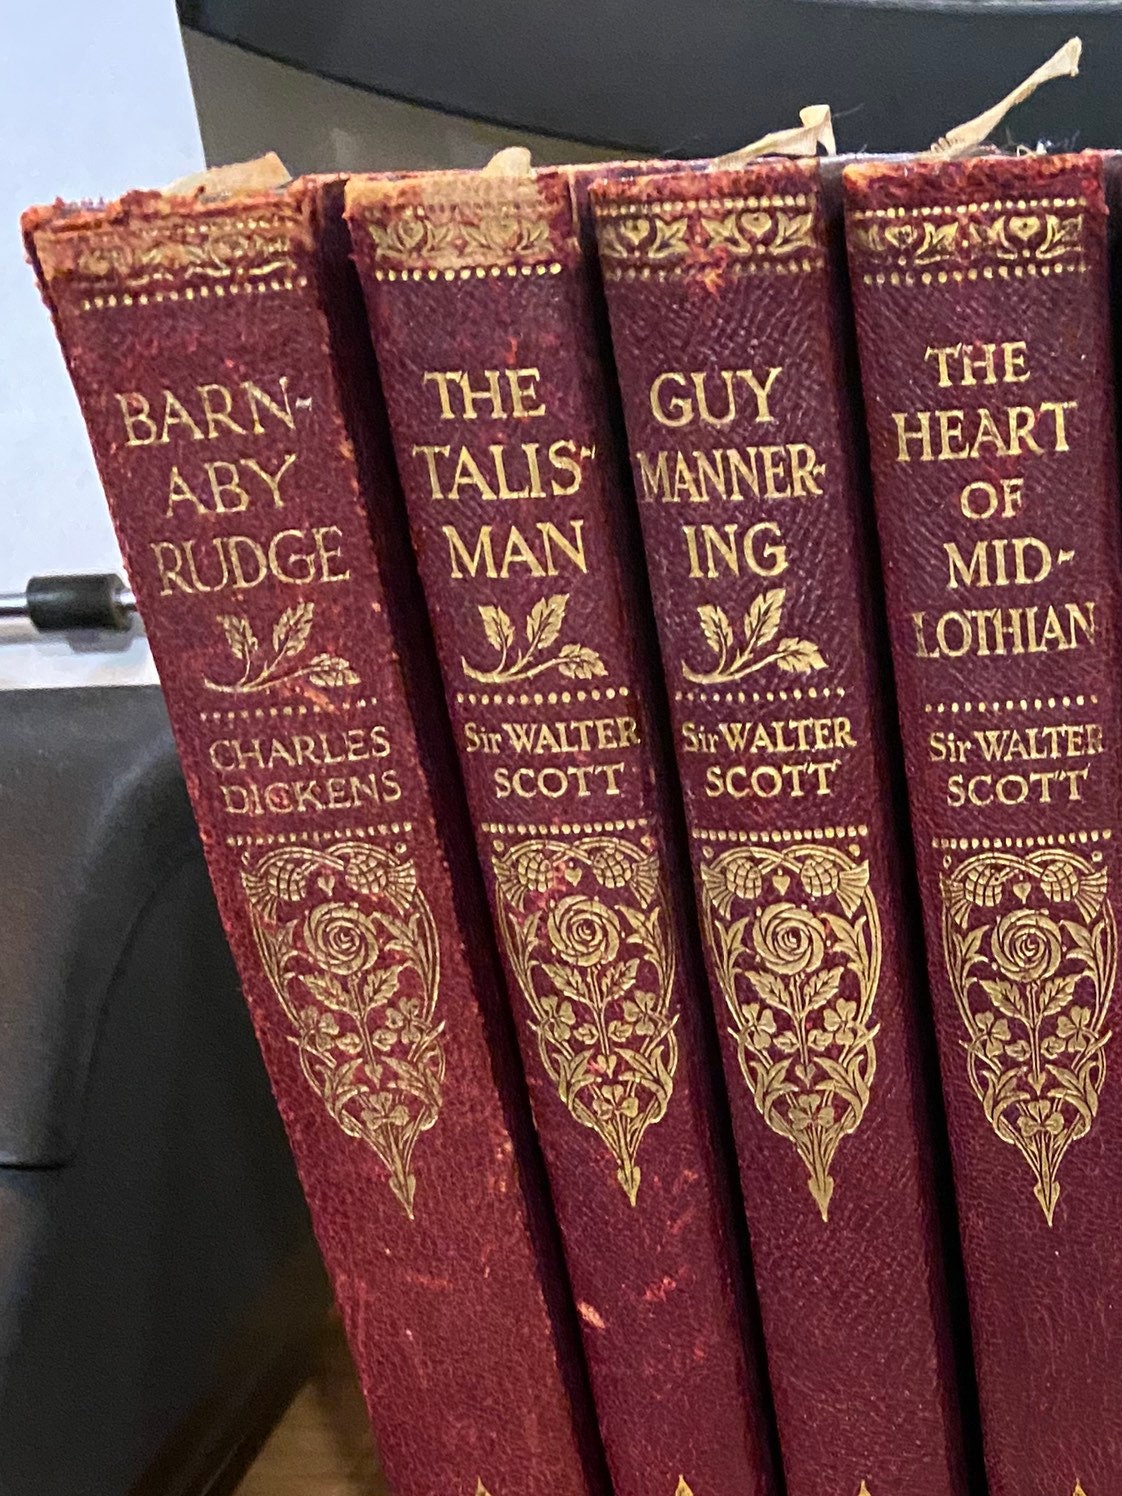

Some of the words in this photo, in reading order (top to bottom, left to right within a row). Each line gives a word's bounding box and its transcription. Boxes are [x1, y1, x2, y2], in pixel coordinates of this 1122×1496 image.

[924, 341, 1031, 388] THE
[423, 367, 546, 420] THE
[650, 367, 783, 428] GUY
[892, 401, 1077, 462] HEART
[165, 453, 297, 518] ABY
[960, 478, 1024, 520] OF
[150, 525, 351, 596] RUDGE
[442, 520, 589, 578] MAN
[683, 521, 789, 579] ING
[911, 601, 1096, 658] LOTHIAN
[209, 726, 391, 770] CHARLES
[464, 721, 502, 754] Sir
[502, 716, 641, 754] WALTER
[682, 721, 719, 754] Sir
[719, 716, 857, 753] WALTER
[928, 732, 972, 763] Sir
[974, 723, 1104, 761] WALTER
[219, 770, 402, 815] DICKENS
[494, 762, 625, 799] SCOTT
[705, 758, 841, 799] SCOTT
[947, 763, 1091, 807] SCOTT
